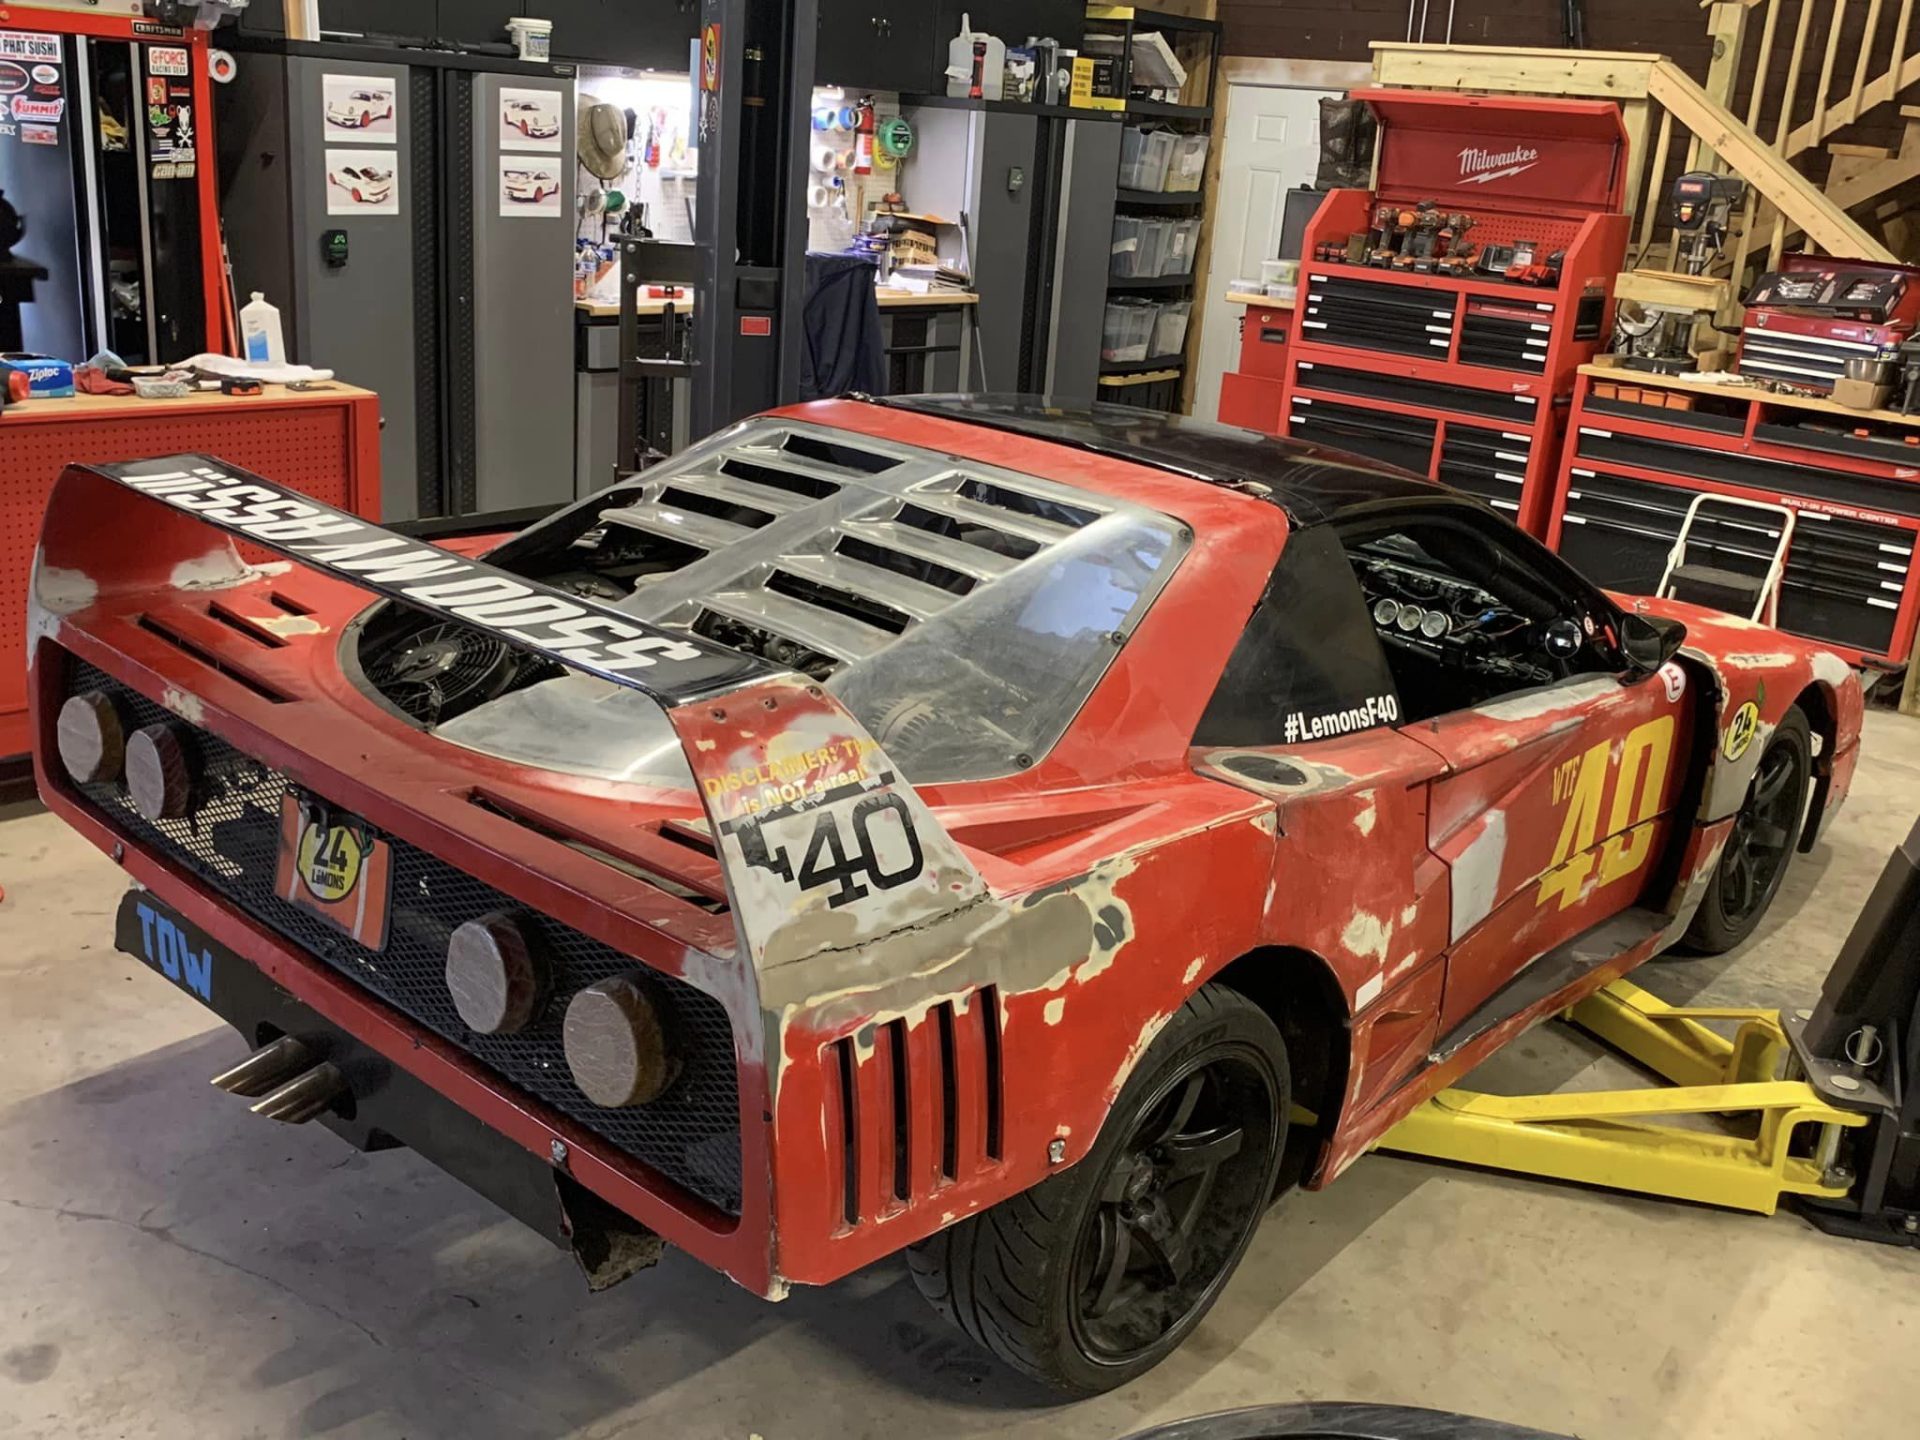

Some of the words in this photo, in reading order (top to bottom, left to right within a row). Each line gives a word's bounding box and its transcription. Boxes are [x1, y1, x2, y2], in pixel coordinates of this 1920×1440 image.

[135, 23, 182, 35] CRAFTSMAN
[28, 41, 57, 56] SUSHI
[1457, 145, 1538, 175] Milwaukee
[28, 367, 60, 382] Ziploc
[1781, 498, 1820, 510] BUILT-IN
[1822, 506, 1857, 518] POWER
[1859, 513, 1898, 524] CENTER
[1284, 694, 1398, 743] #LemonsF40
[741, 796, 761, 814] is
[764, 779, 806, 807] NOT
[1552, 755, 1580, 806] WTF
[1536, 715, 1674, 911] 40
[313, 824, 348, 872] 24
[136, 901, 212, 1002] TOW
